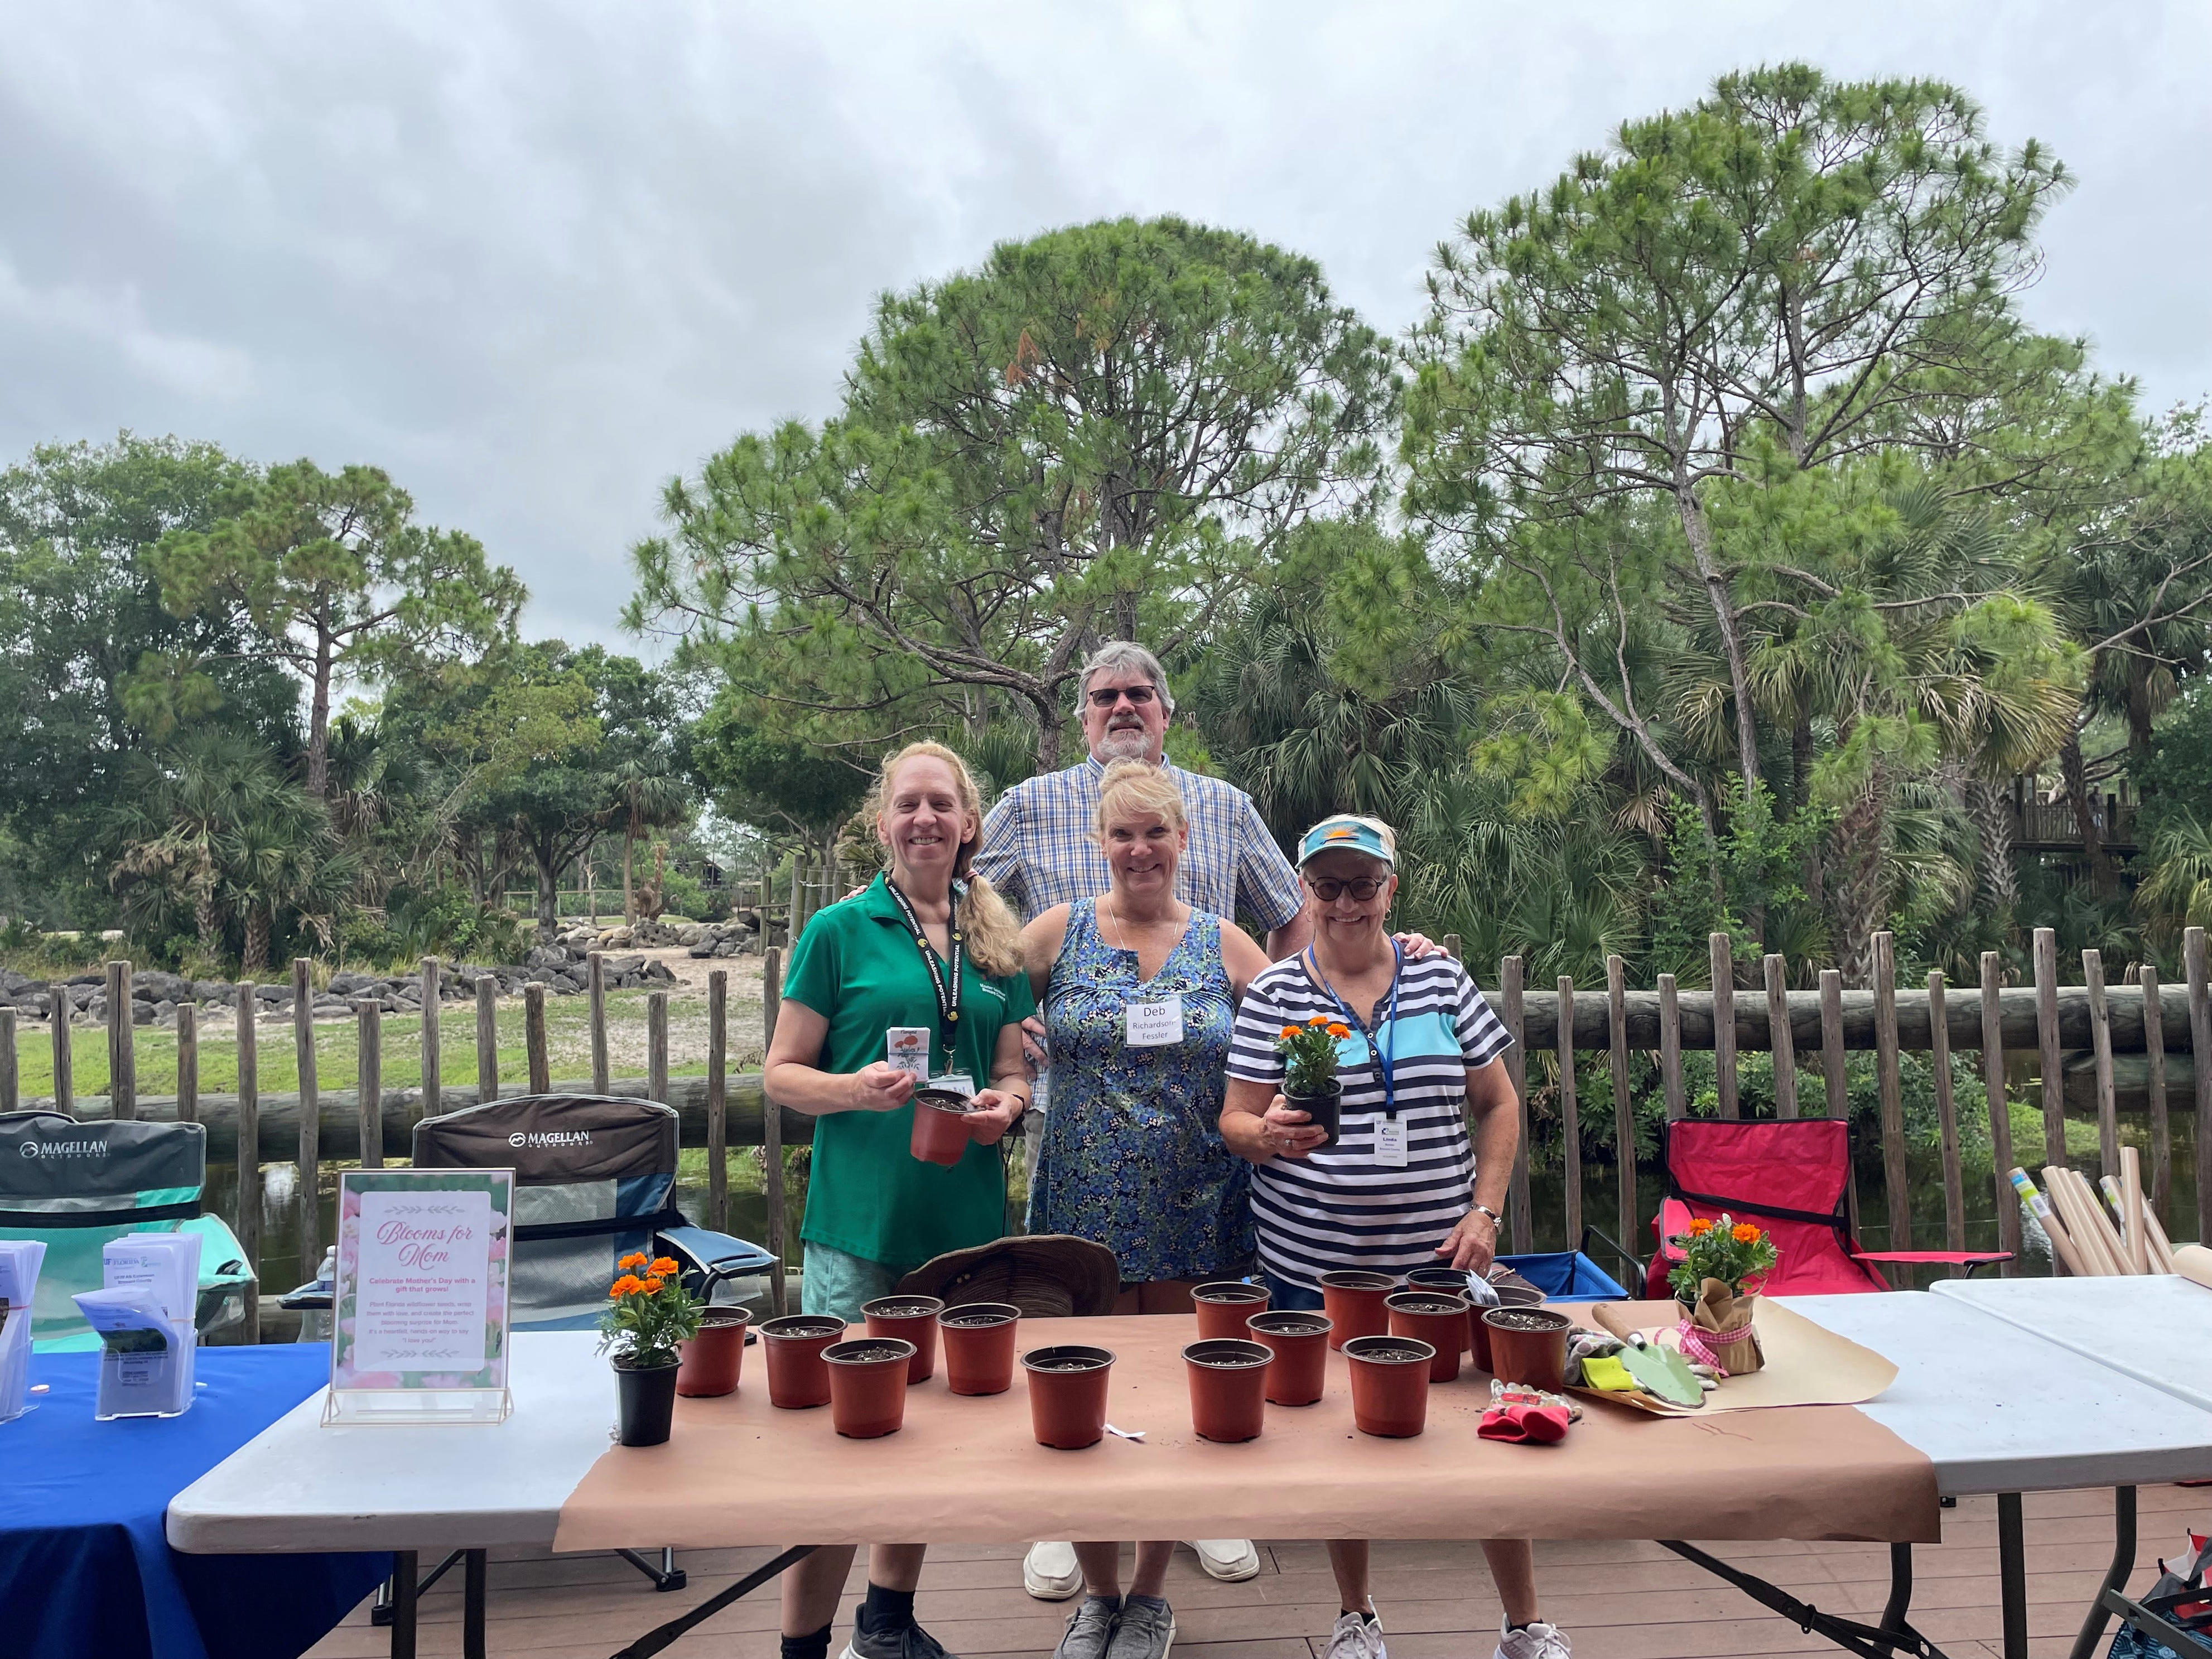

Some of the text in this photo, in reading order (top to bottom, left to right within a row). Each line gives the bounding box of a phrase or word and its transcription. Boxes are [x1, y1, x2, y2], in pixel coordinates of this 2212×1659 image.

[905, 910, 921, 935] POTENTIAL
[925, 950, 941, 984] UNLEASHING
[1144, 1005, 1165, 1016] Deb
[1133, 1021, 1177, 1029] Richardson-
[528, 1130, 589, 1144] MAGELLAN
[41, 1140, 108, 1154] MAGELLAN
[377, 1221, 473, 1245] Blooms for
[398, 1243, 449, 1270] Mom
